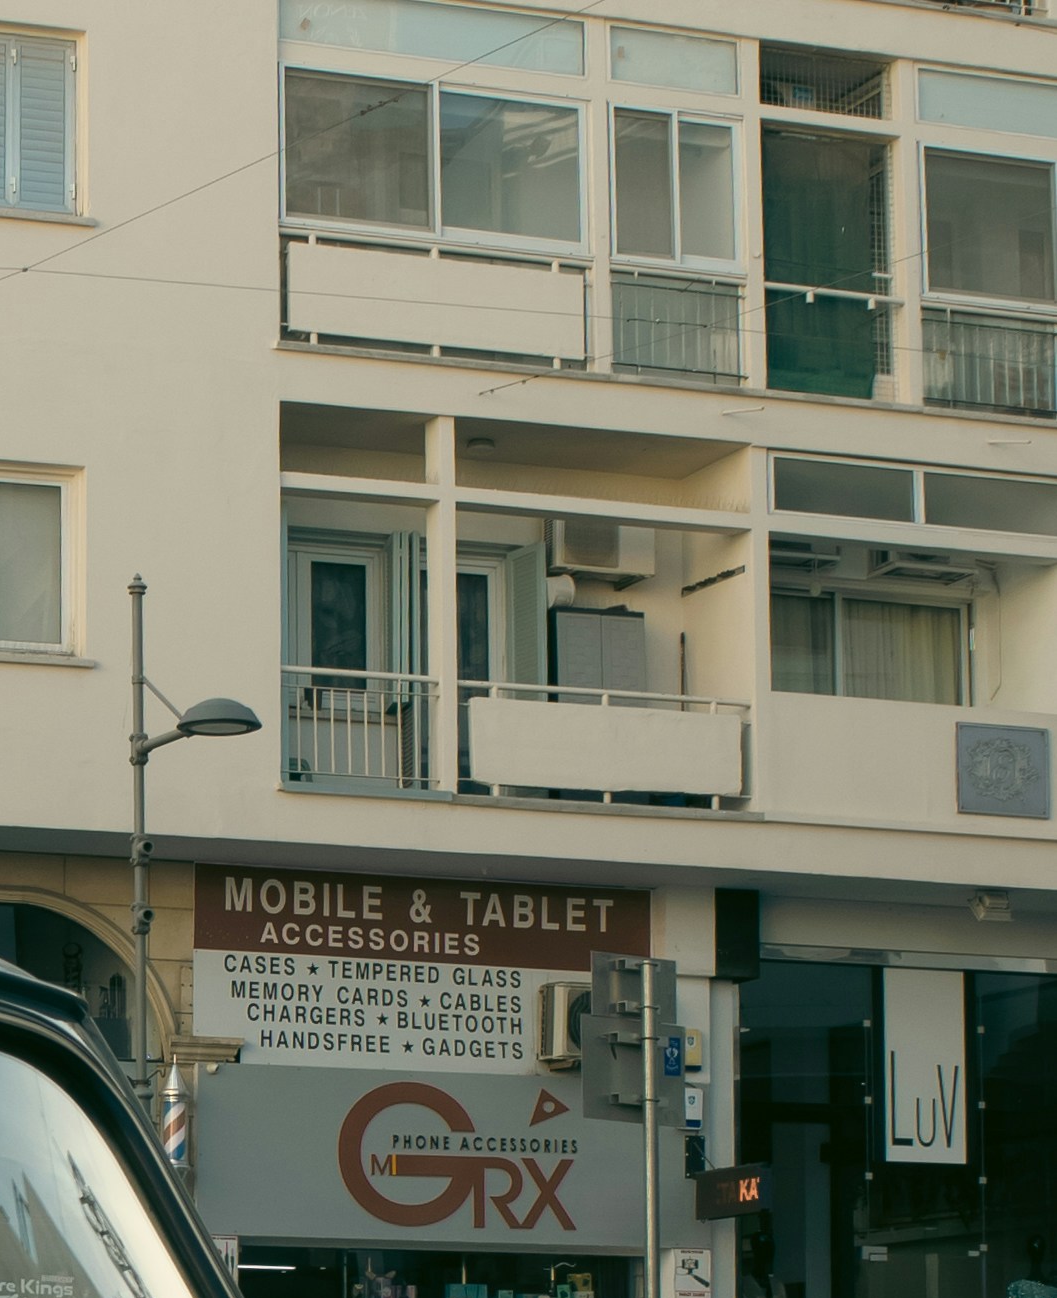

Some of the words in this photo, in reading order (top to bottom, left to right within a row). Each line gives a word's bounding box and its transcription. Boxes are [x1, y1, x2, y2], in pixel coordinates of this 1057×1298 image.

[225, 877, 383, 920] MOBILE
[409, 889, 432, 923] &
[460, 892, 614, 933] TABLET
[260, 922, 480, 956] ACCESSORIES
[224, 954, 295, 976] CASES
[328, 961, 439, 984] TEMPERED
[453, 967, 521, 989] GLASS
[231, 980, 323, 1002] MEMORY
[337, 986, 408, 1008] CARDS
[440, 992, 521, 1013] CABLES
[247, 1003, 365, 1027] CHARGERS
[397, 1011, 522, 1035] BLUETOOTH
[260, 1029, 390, 1053] HANDSFREE
[422, 1037, 523, 1060] GADGETS
[392, 1134, 451, 1150] PHONE
[459, 1136, 579, 1154] ACCESSORIES
[20, 1278, 74, 1298] Kings
